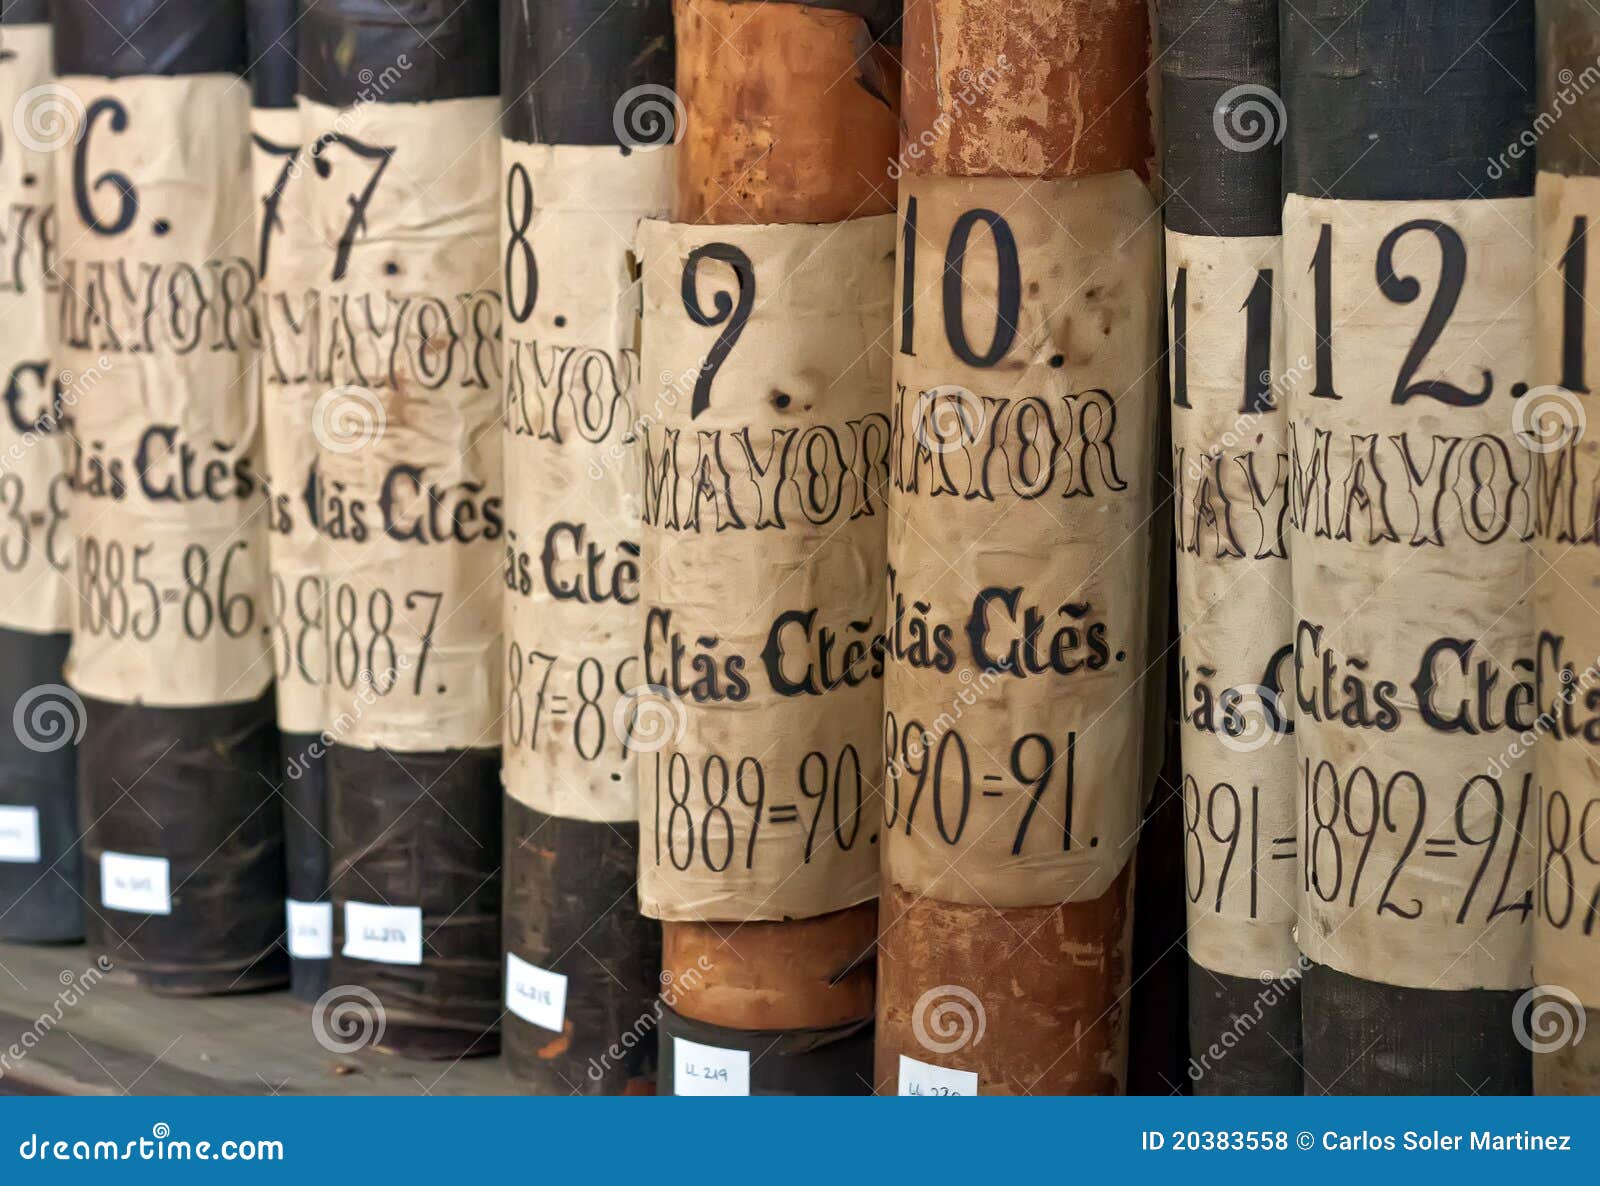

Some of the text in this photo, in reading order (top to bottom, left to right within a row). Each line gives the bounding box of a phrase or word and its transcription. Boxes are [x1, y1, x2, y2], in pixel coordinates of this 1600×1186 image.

[506, 162, 568, 324] 8.
[899, 194, 1065, 368] 10.
[1307, 218, 1530, 408] 12.
[312, 290, 502, 391] AYOR
[681, 242, 792, 421] 9.
